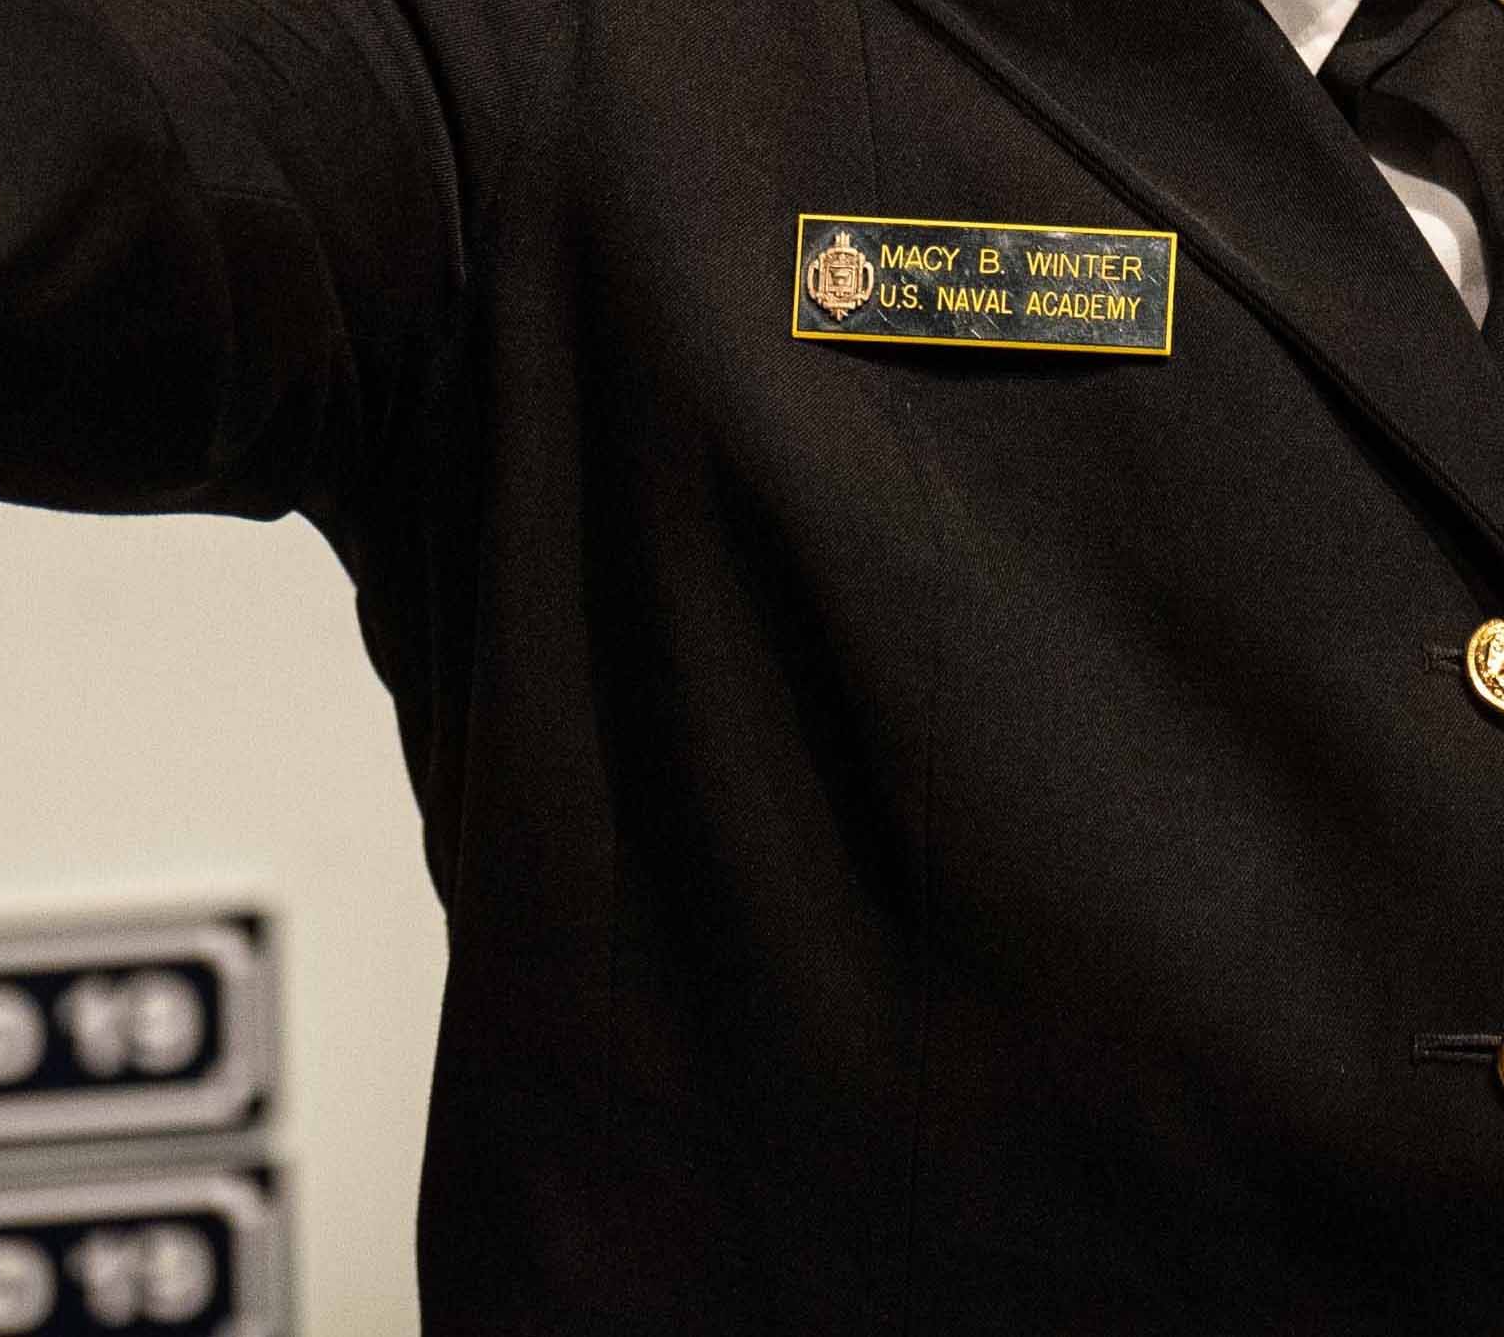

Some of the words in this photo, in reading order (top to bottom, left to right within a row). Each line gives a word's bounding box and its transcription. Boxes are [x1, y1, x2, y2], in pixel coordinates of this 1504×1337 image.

[880, 244, 961, 273] MACY
[978, 249, 1006, 276] B.
[1026, 252, 1143, 282] WINTER
[879, 284, 924, 311] U.S.
[936, 286, 1013, 315] NAVAL
[1025, 291, 1142, 321] ACADEMY
